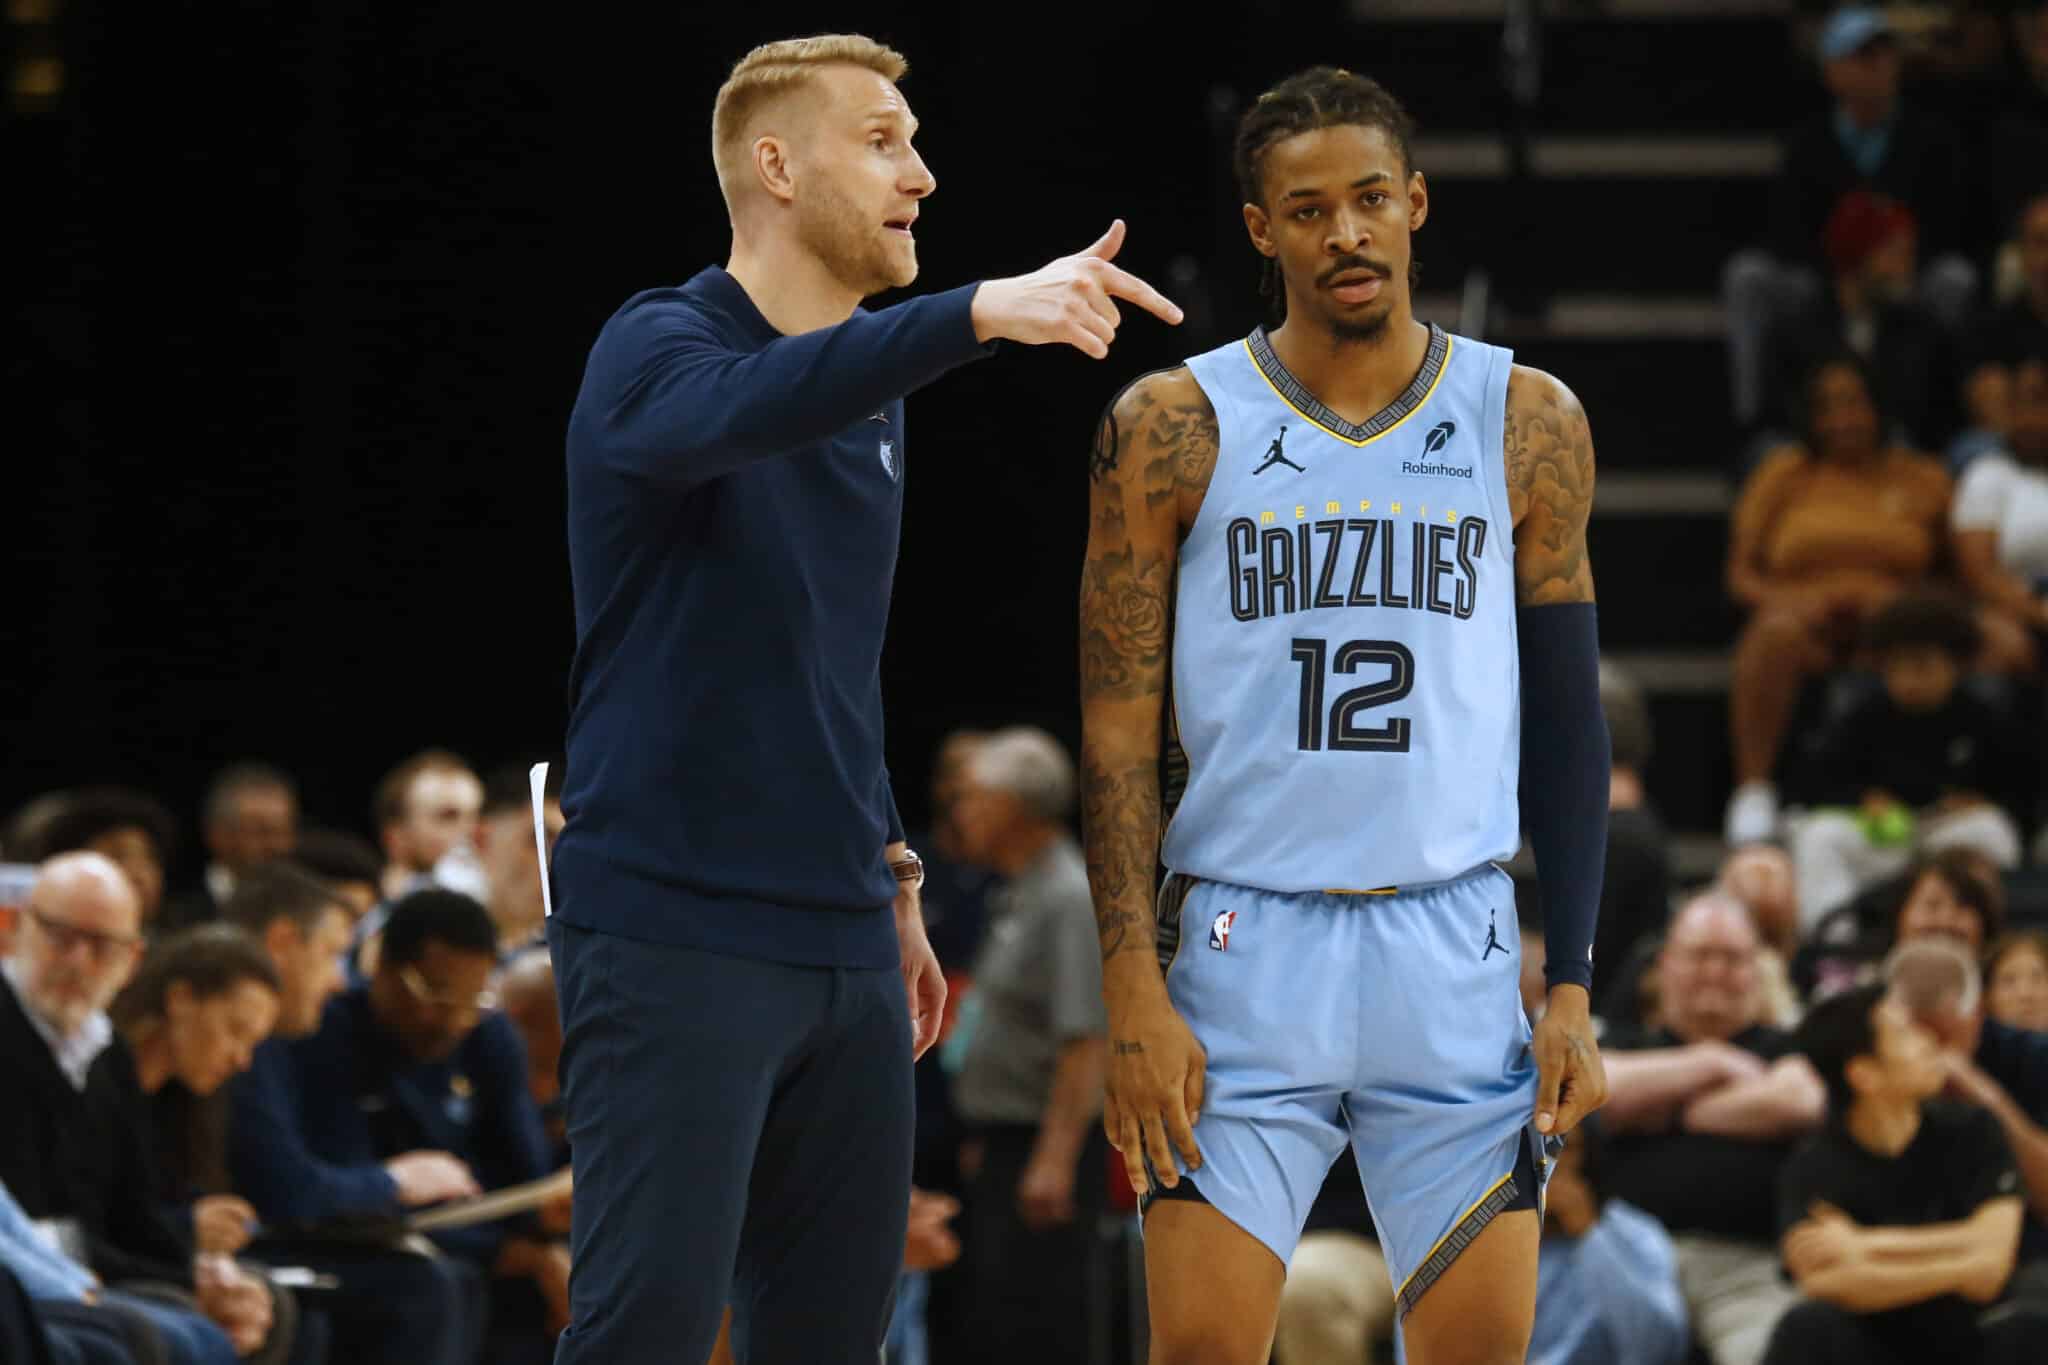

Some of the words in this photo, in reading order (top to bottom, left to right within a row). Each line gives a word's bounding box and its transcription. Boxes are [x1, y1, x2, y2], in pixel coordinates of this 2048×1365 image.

[1402, 461, 1473, 479] Robinhood
[1226, 515, 1488, 622] GRIZZLIES
[1291, 637, 1416, 753] 12
